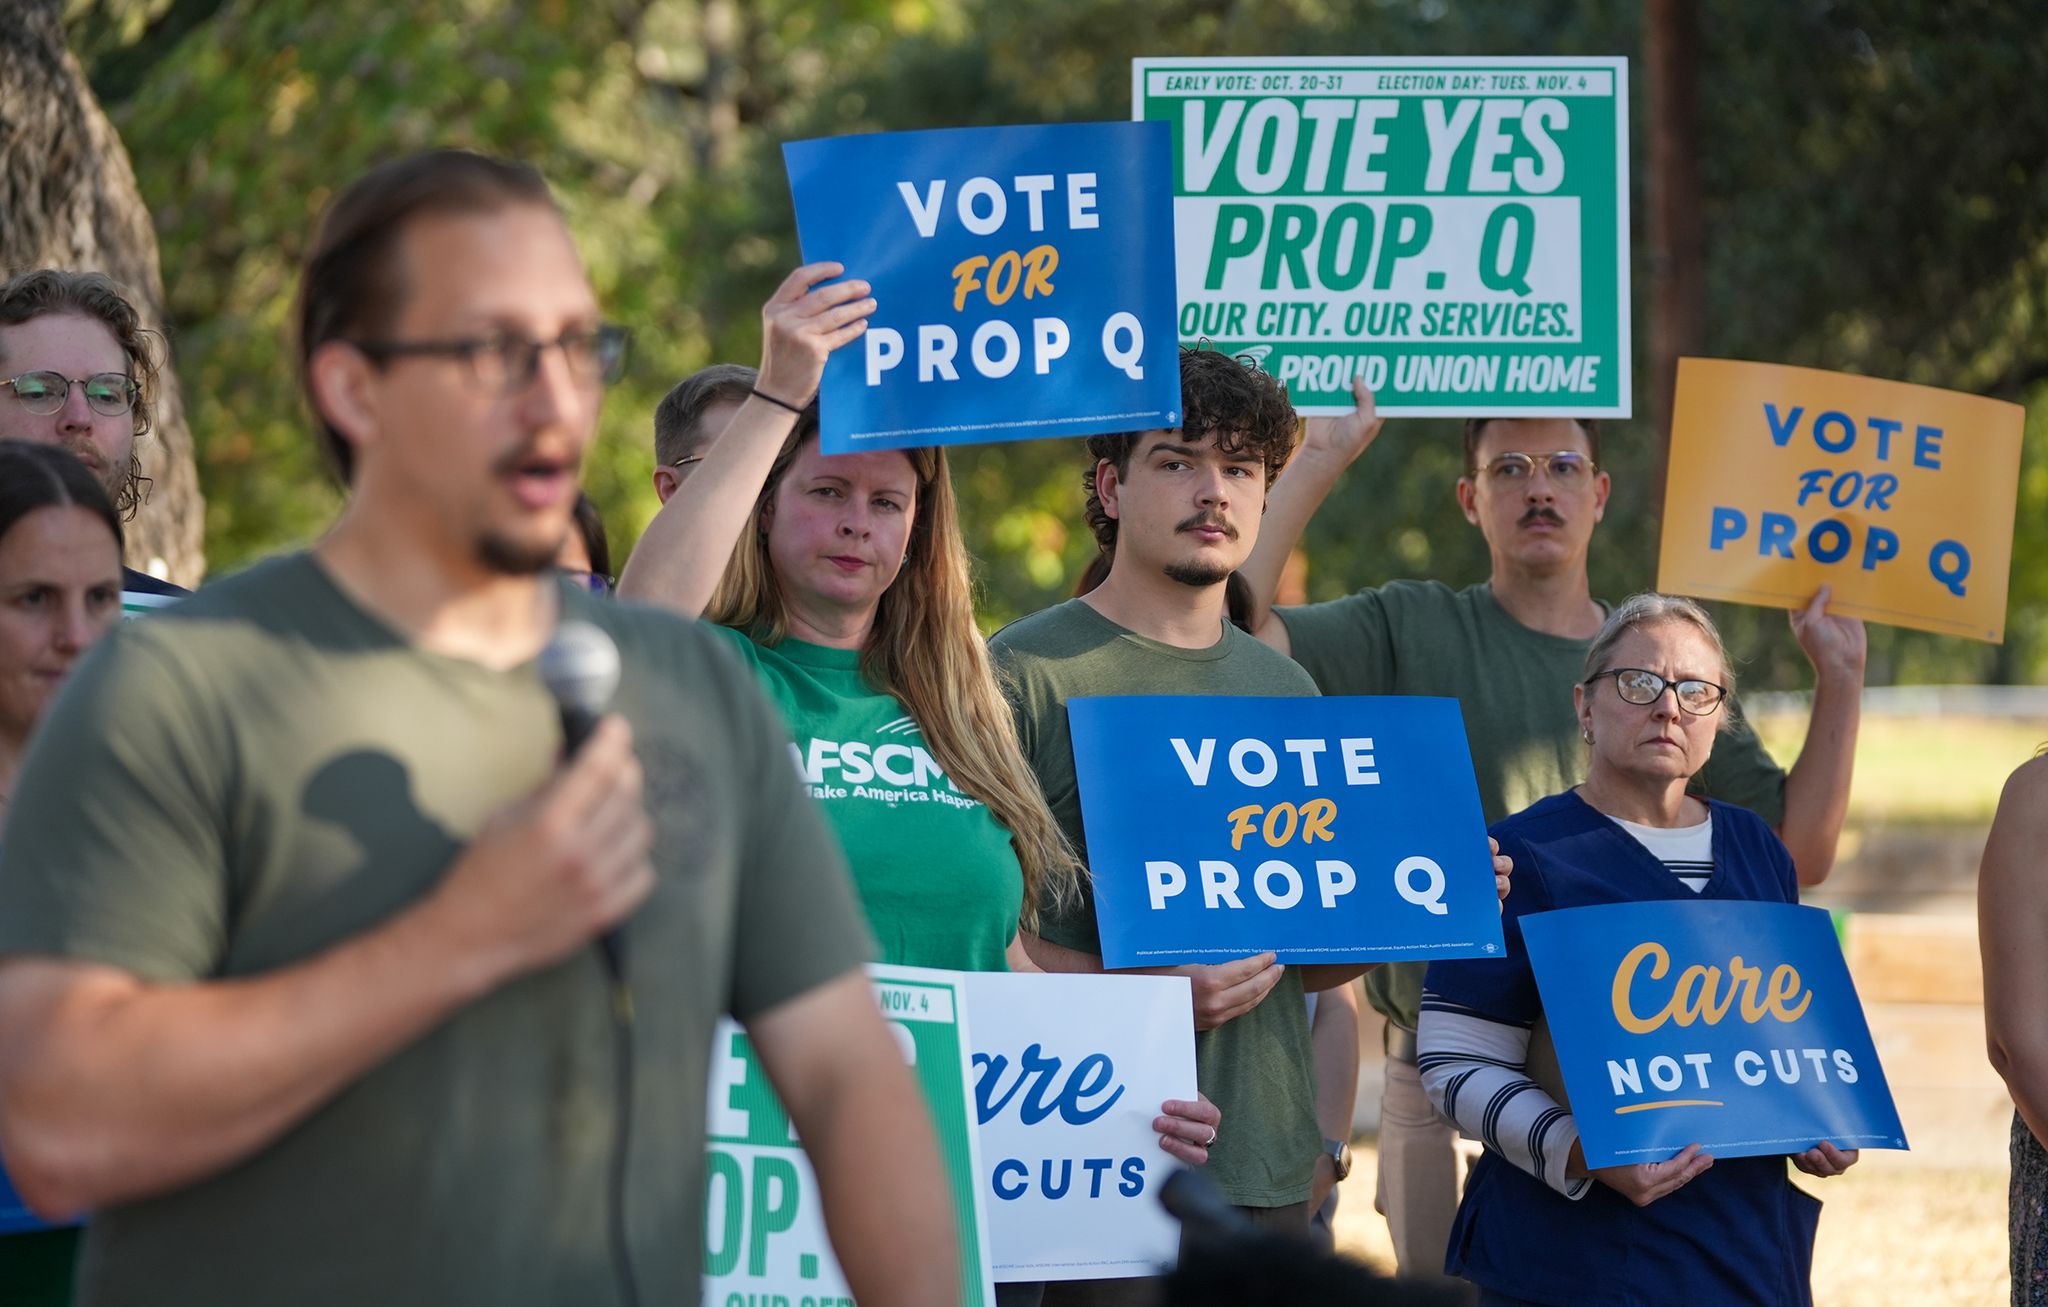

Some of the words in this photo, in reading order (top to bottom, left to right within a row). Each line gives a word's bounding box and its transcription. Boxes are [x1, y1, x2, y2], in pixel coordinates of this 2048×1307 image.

[1165, 76, 1210, 91] EARLY
[1215, 76, 1257, 91] VOTE:
[1262, 76, 1294, 91] OCT.
[1299, 76, 1343, 91] 20-31
[1377, 75, 1446, 90] ELECTION
[1452, 75, 1485, 90] DAY:
[1491, 75, 1530, 90] TUES.
[1536, 75, 1573, 90] NOV.
[1577, 75, 1587, 90] 4
[1184, 98, 1399, 193] VOTE
[1423, 98, 1570, 194] YES
[897, 172, 1100, 238] VOTE
[951, 244, 1059, 313] FOR
[1204, 202, 1447, 292] PROP.
[1478, 202, 1536, 298] Q
[1178, 301, 1247, 337] OUR
[1255, 301, 1332, 337] CITY.
[1344, 301, 1412, 337] OUR
[1420, 302, 1574, 337] SERVICES.
[865, 316, 1071, 387] PROP
[1102, 311, 1144, 381] Q
[1278, 354, 1388, 393] PROUD
[1393, 354, 1501, 393] UNION
[1505, 354, 1601, 393] HOME
[1763, 402, 1944, 470] VOTE
[1796, 469, 1899, 512] FOR
[1709, 506, 1900, 571] PROP
[1928, 539, 1972, 597] Q
[786, 737, 964, 795] FSCM
[1169, 737, 1381, 788] VOTE
[852, 784, 930, 802] America
[931, 788, 985, 809] Happ
[1227, 798, 1338, 851] FOR
[1144, 860, 1357, 910] PROP
[1394, 856, 1449, 915] Q
[880, 990, 915, 1012] NOV.
[920, 993, 929, 1013] 4
[1611, 941, 1813, 1035] Care
[971, 1042, 1126, 1126] are
[1606, 1052, 1713, 1096] NOT
[1734, 1048, 1859, 1086] CUTS
[991, 1155, 1147, 1201] CUTS
[703, 1150, 819, 1280] OP.
